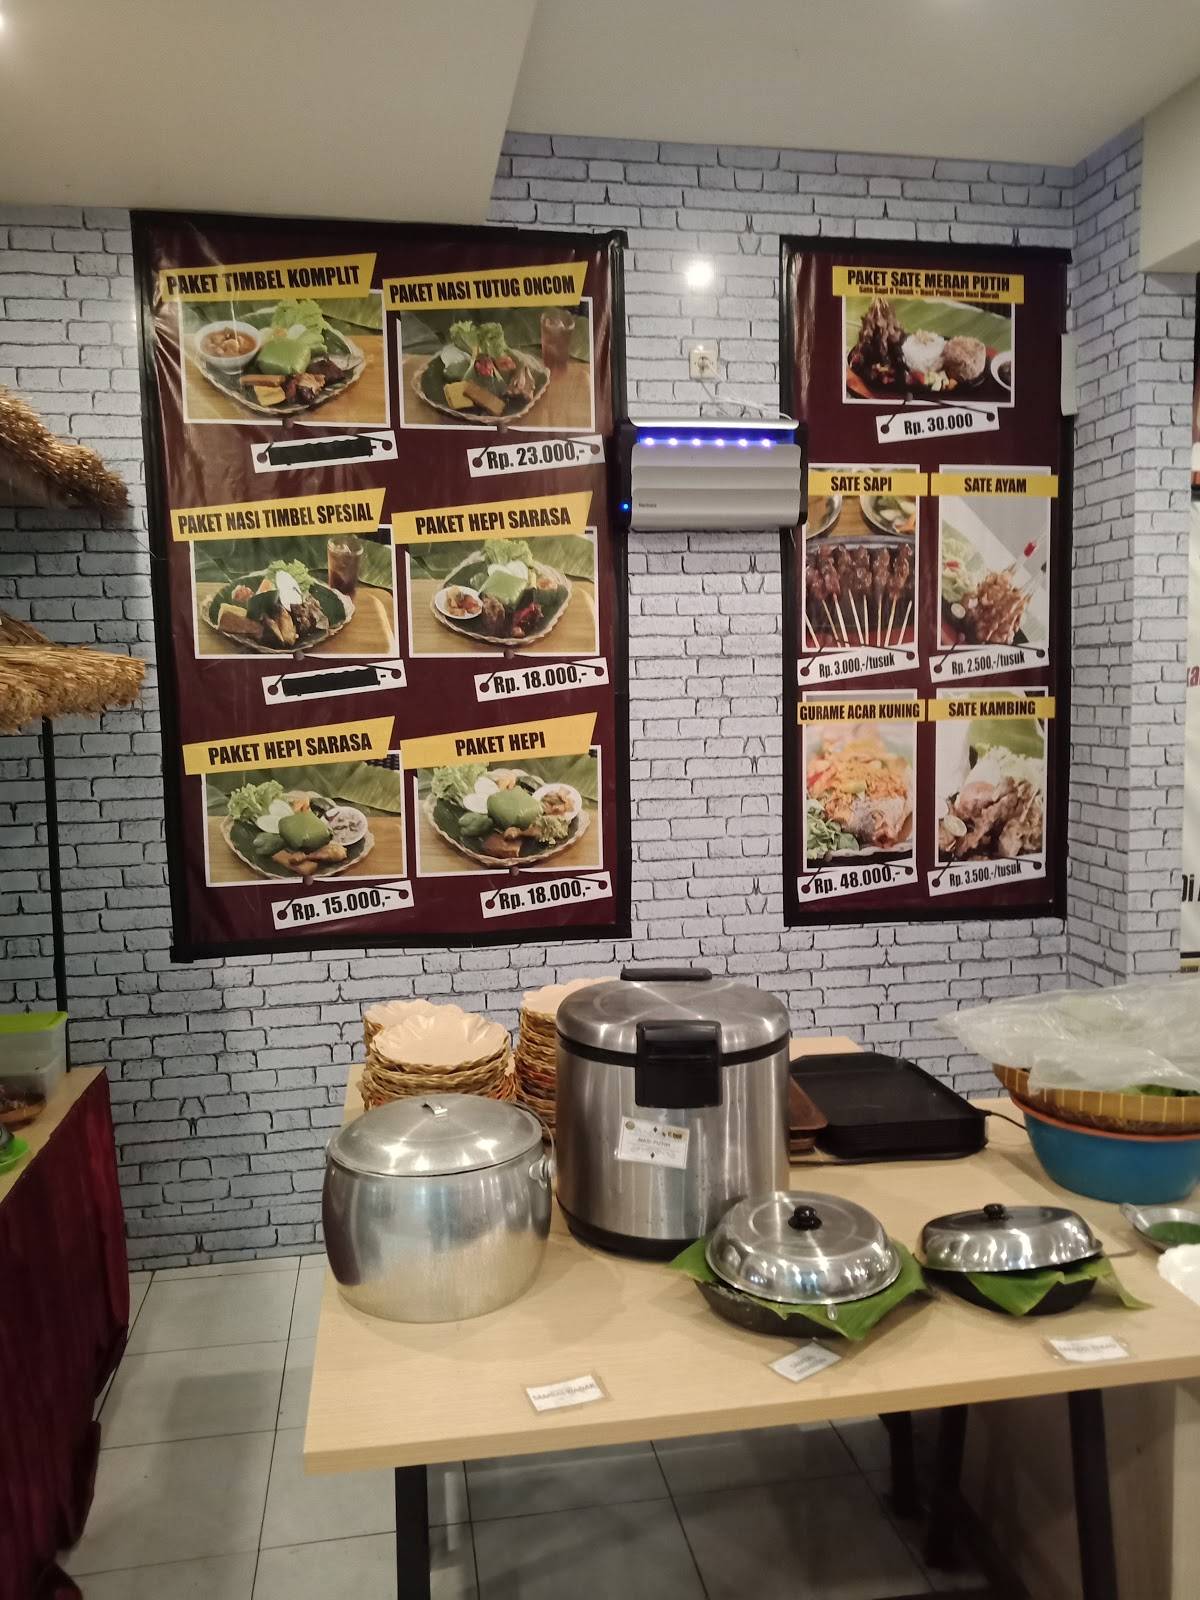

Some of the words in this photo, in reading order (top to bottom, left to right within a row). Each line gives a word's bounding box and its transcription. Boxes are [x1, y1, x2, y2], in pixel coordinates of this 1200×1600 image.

[166, 273, 218, 296] PAKET
[224, 268, 285, 293] TIMBEL
[287, 265, 360, 287] KOMPLIT
[389, 282, 434, 304] PAKET
[436, 281, 470, 300] NASI
[473, 279, 520, 298] TUTUG
[523, 275, 575, 296] ONCOM
[847, 269, 888, 286] PAKET
[890, 271, 922, 288] SATE
[924, 273, 970, 290] MERAH
[972, 275, 1010, 292] PUTIH
[904, 420, 924, 436] Rp.
[926, 413, 973, 434] 30.000
[486, 450, 514, 470] Rp.
[516, 442, 585, 467] 23.000,-
[830, 476, 860, 492] SATE
[863, 476, 892, 492] SAPI
[964, 478, 993, 493] SATE
[994, 478, 1027, 493] AYAM
[178, 514, 222, 534] PAKET
[226, 510, 260, 531] NASI
[262, 506, 315, 528] TIMBEL
[316, 502, 374, 524] SPESIAL
[415, 514, 464, 536] PAKET
[469, 512, 504, 532] HEPI
[508, 506, 571, 528] SARASA
[493, 675, 520, 694] Rp.
[522, 666, 588, 690] 18.000,-
[819, 662, 832, 678] Rp.
[952, 660, 966, 676] Rp.
[800, 704, 845, 721] GURAME
[847, 704, 877, 720] ACAR
[878, 703, 920, 719] KUNING
[948, 702, 977, 718] SATE
[979, 701, 1036, 717] KAMBING
[208, 743, 260, 766] PAKET
[264, 739, 303, 760] HEPI
[305, 732, 372, 756] SARASA
[455, 735, 504, 756] PAKET
[508, 731, 546, 752] HEPI
[814, 876, 837, 896] Rp.
[839, 865, 900, 890] 48.000,-
[949, 872, 964, 888] Rp.
[291, 902, 320, 922] Rp.
[322, 888, 392, 916] 15.000,-
[499, 892, 526, 910] Rp.
[527, 879, 592, 904] 18.000,-
